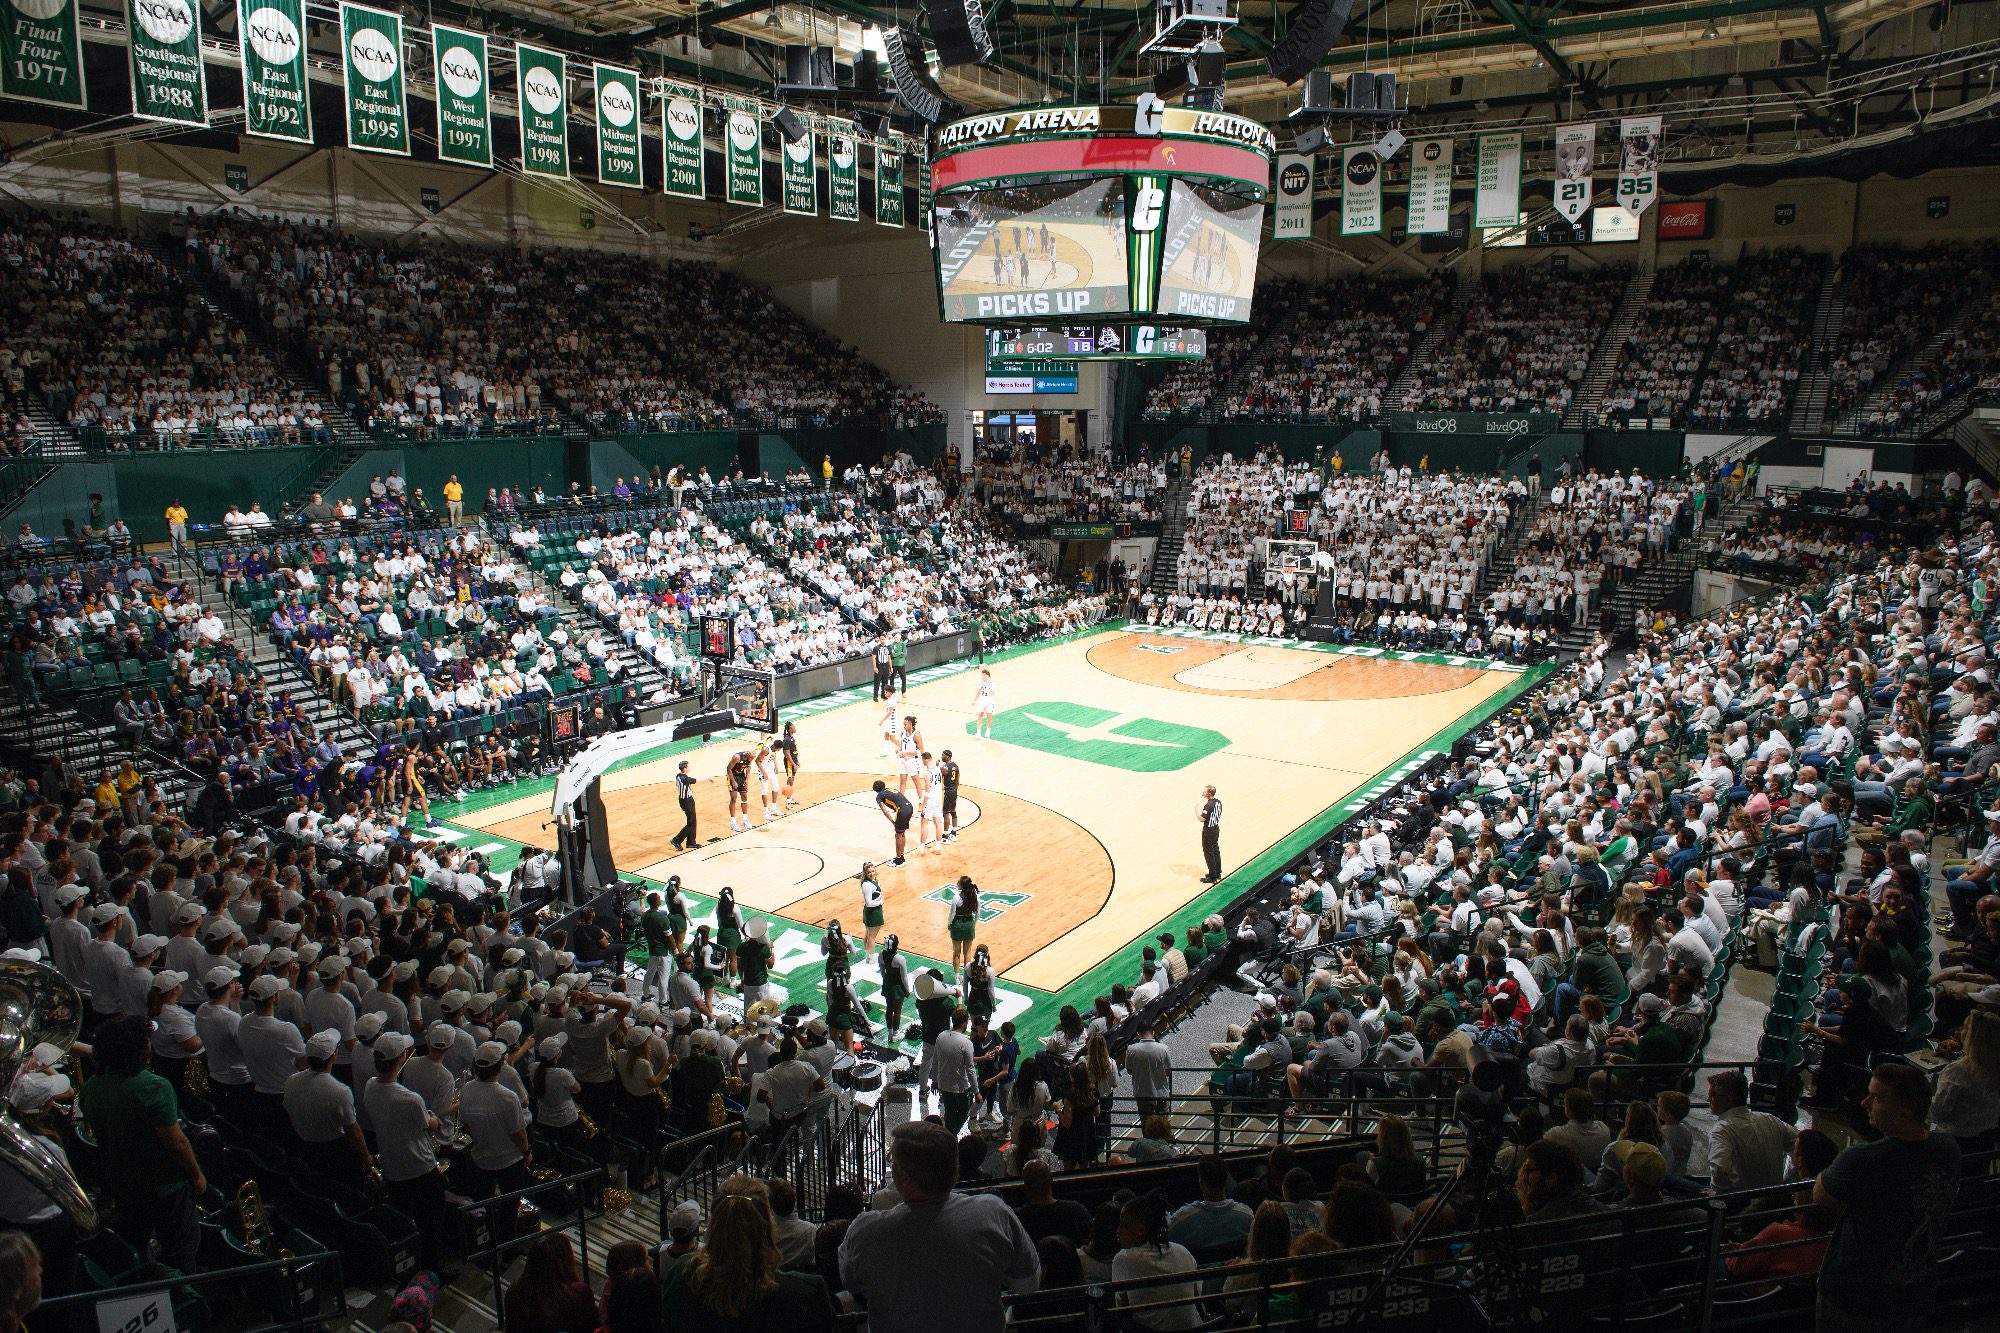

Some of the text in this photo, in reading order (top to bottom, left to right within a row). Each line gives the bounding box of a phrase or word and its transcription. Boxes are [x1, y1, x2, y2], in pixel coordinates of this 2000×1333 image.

[138, 0, 190, 25] NCAA
[15, 19, 62, 43] Final
[251, 25, 296, 47] NCAA
[18, 40, 61, 62] Four
[135, 43, 199, 67] Southeast
[353, 45, 394, 66] NCAA
[14, 59, 67, 87] 1977
[138, 60, 197, 83] Regional
[262, 66, 290, 84] East
[443, 62, 480, 82] NCAA
[147, 84, 194, 108] 1988
[251, 81, 302, 102] Regional
[363, 84, 388, 100] East
[527, 81, 559, 100] NCAA
[354, 98, 401, 118] Regional
[451, 98, 476, 114] West
[603, 95, 633, 112] NCAA
[257, 102, 299, 125] 1992
[443, 110, 485, 130] Regional
[669, 109, 697, 126] NCAA
[358, 118, 399, 139] 1995
[534, 116, 554, 130] East
[731, 123, 756, 137] NCAA
[939, 109, 1099, 146] HALTON ARENA
[1198, 112, 1261, 143] HALTON
[447, 130, 481, 149] 1997
[527, 128, 563, 145] Regional
[602, 128, 636, 143] Midwest
[530, 147, 561, 165] 1998
[603, 140, 636, 156] Regional
[668, 139, 700, 155] Midwest
[606, 157, 634, 174] 1999
[668, 152, 699, 168] Regional
[734, 153, 754, 165] South
[671, 168, 697, 186] 2001
[731, 163, 759, 178] Regional
[1348, 164, 1376, 175] NCAA
[733, 180, 757, 195] 2002
[1284, 177, 1306, 189] NIT
[1561, 183, 1585, 200] 21
[1620, 176, 1653, 196] 35
[790, 194, 812, 210] 2004
[1280, 218, 1305, 229] 2011
[1348, 216, 1375, 229] 2022
[978, 290, 1090, 316] PICKS UP
[1177, 291, 1236, 318] PICKS UP
[1003, 342, 1015, 354] 19
[1026, 342, 1054, 354] 6:02
[1416, 418, 1457, 433] blvd98
[1486, 419, 1529, 434] blvd98
[1921, 572, 1936, 583] 49
[557, 721, 571, 737] 30
[1542, 1254, 1580, 1273] 123
[1540, 1273, 1585, 1295] 223
